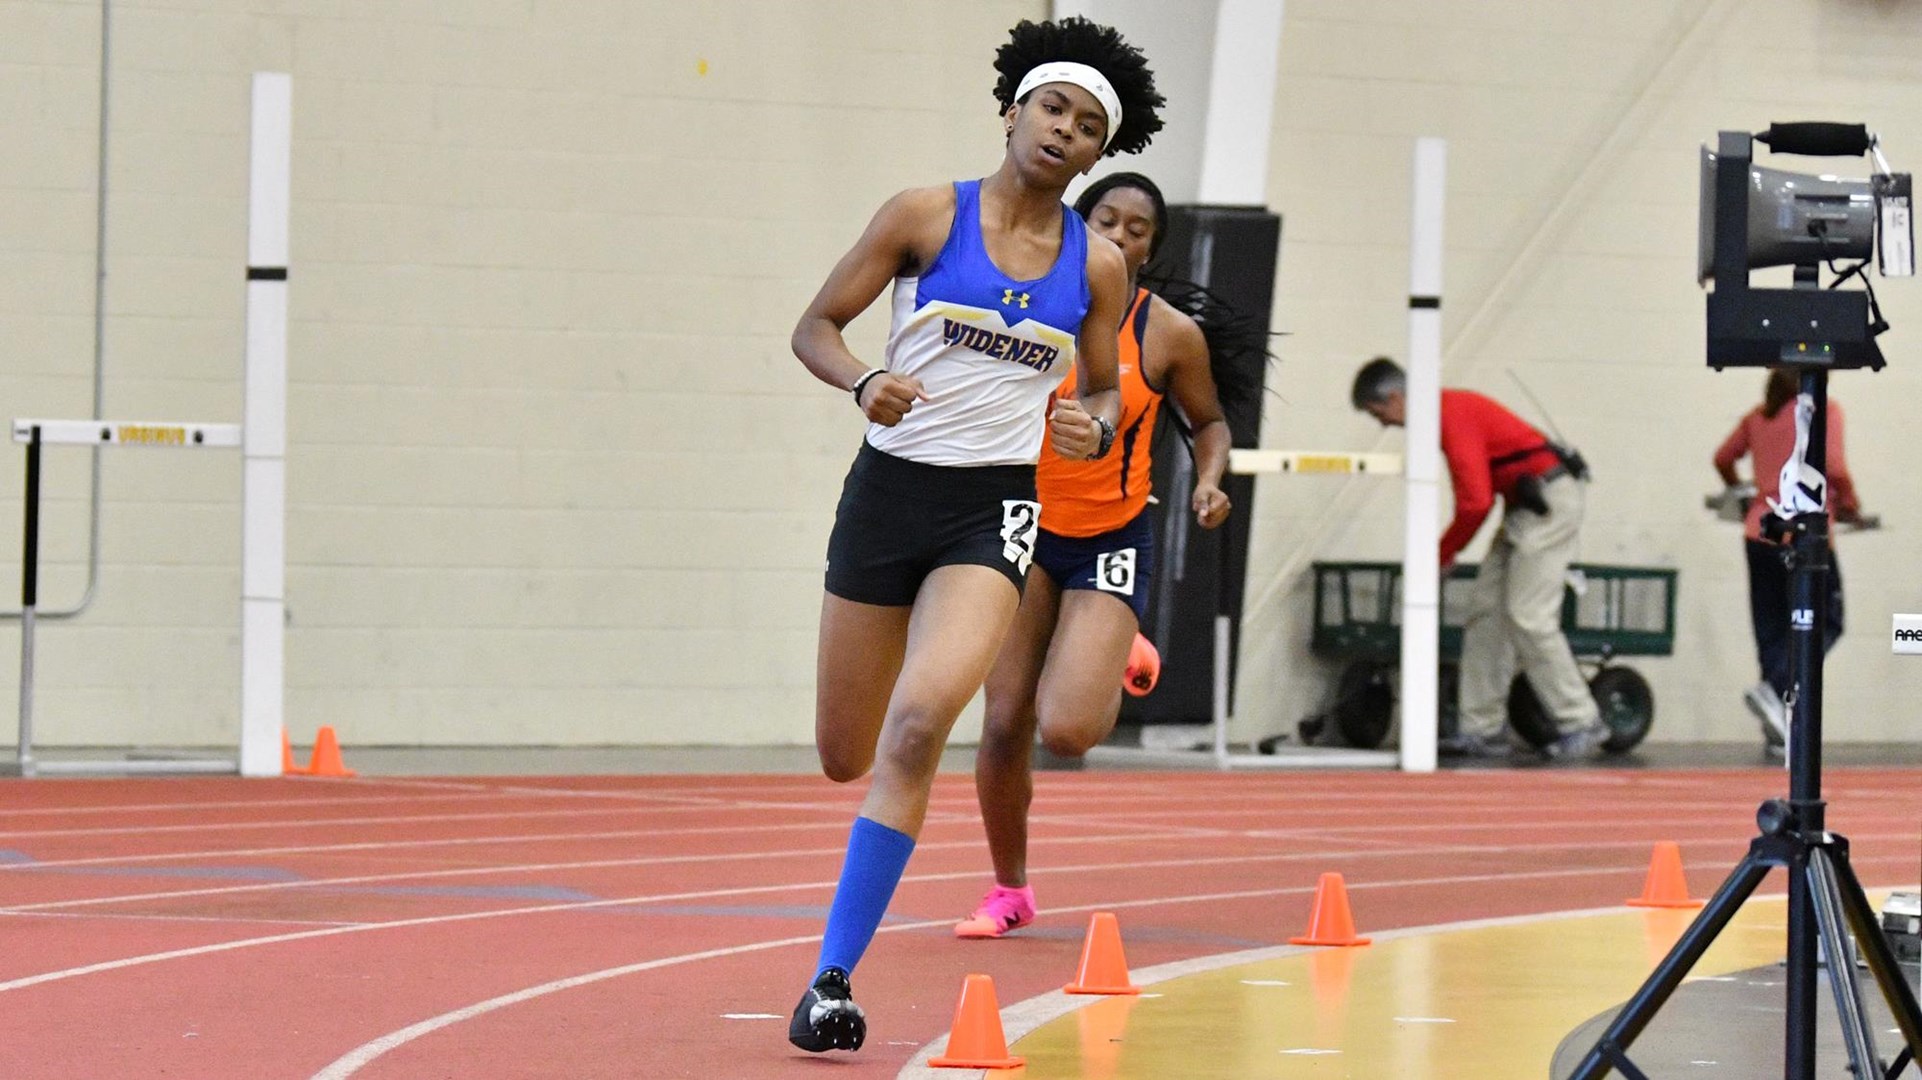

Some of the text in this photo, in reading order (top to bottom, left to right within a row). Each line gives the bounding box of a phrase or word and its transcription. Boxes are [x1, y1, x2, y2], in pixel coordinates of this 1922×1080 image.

[944, 318, 1059, 373] WIDENER
[1010, 503, 1034, 553] 2
[1104, 552, 1128, 588] 6
